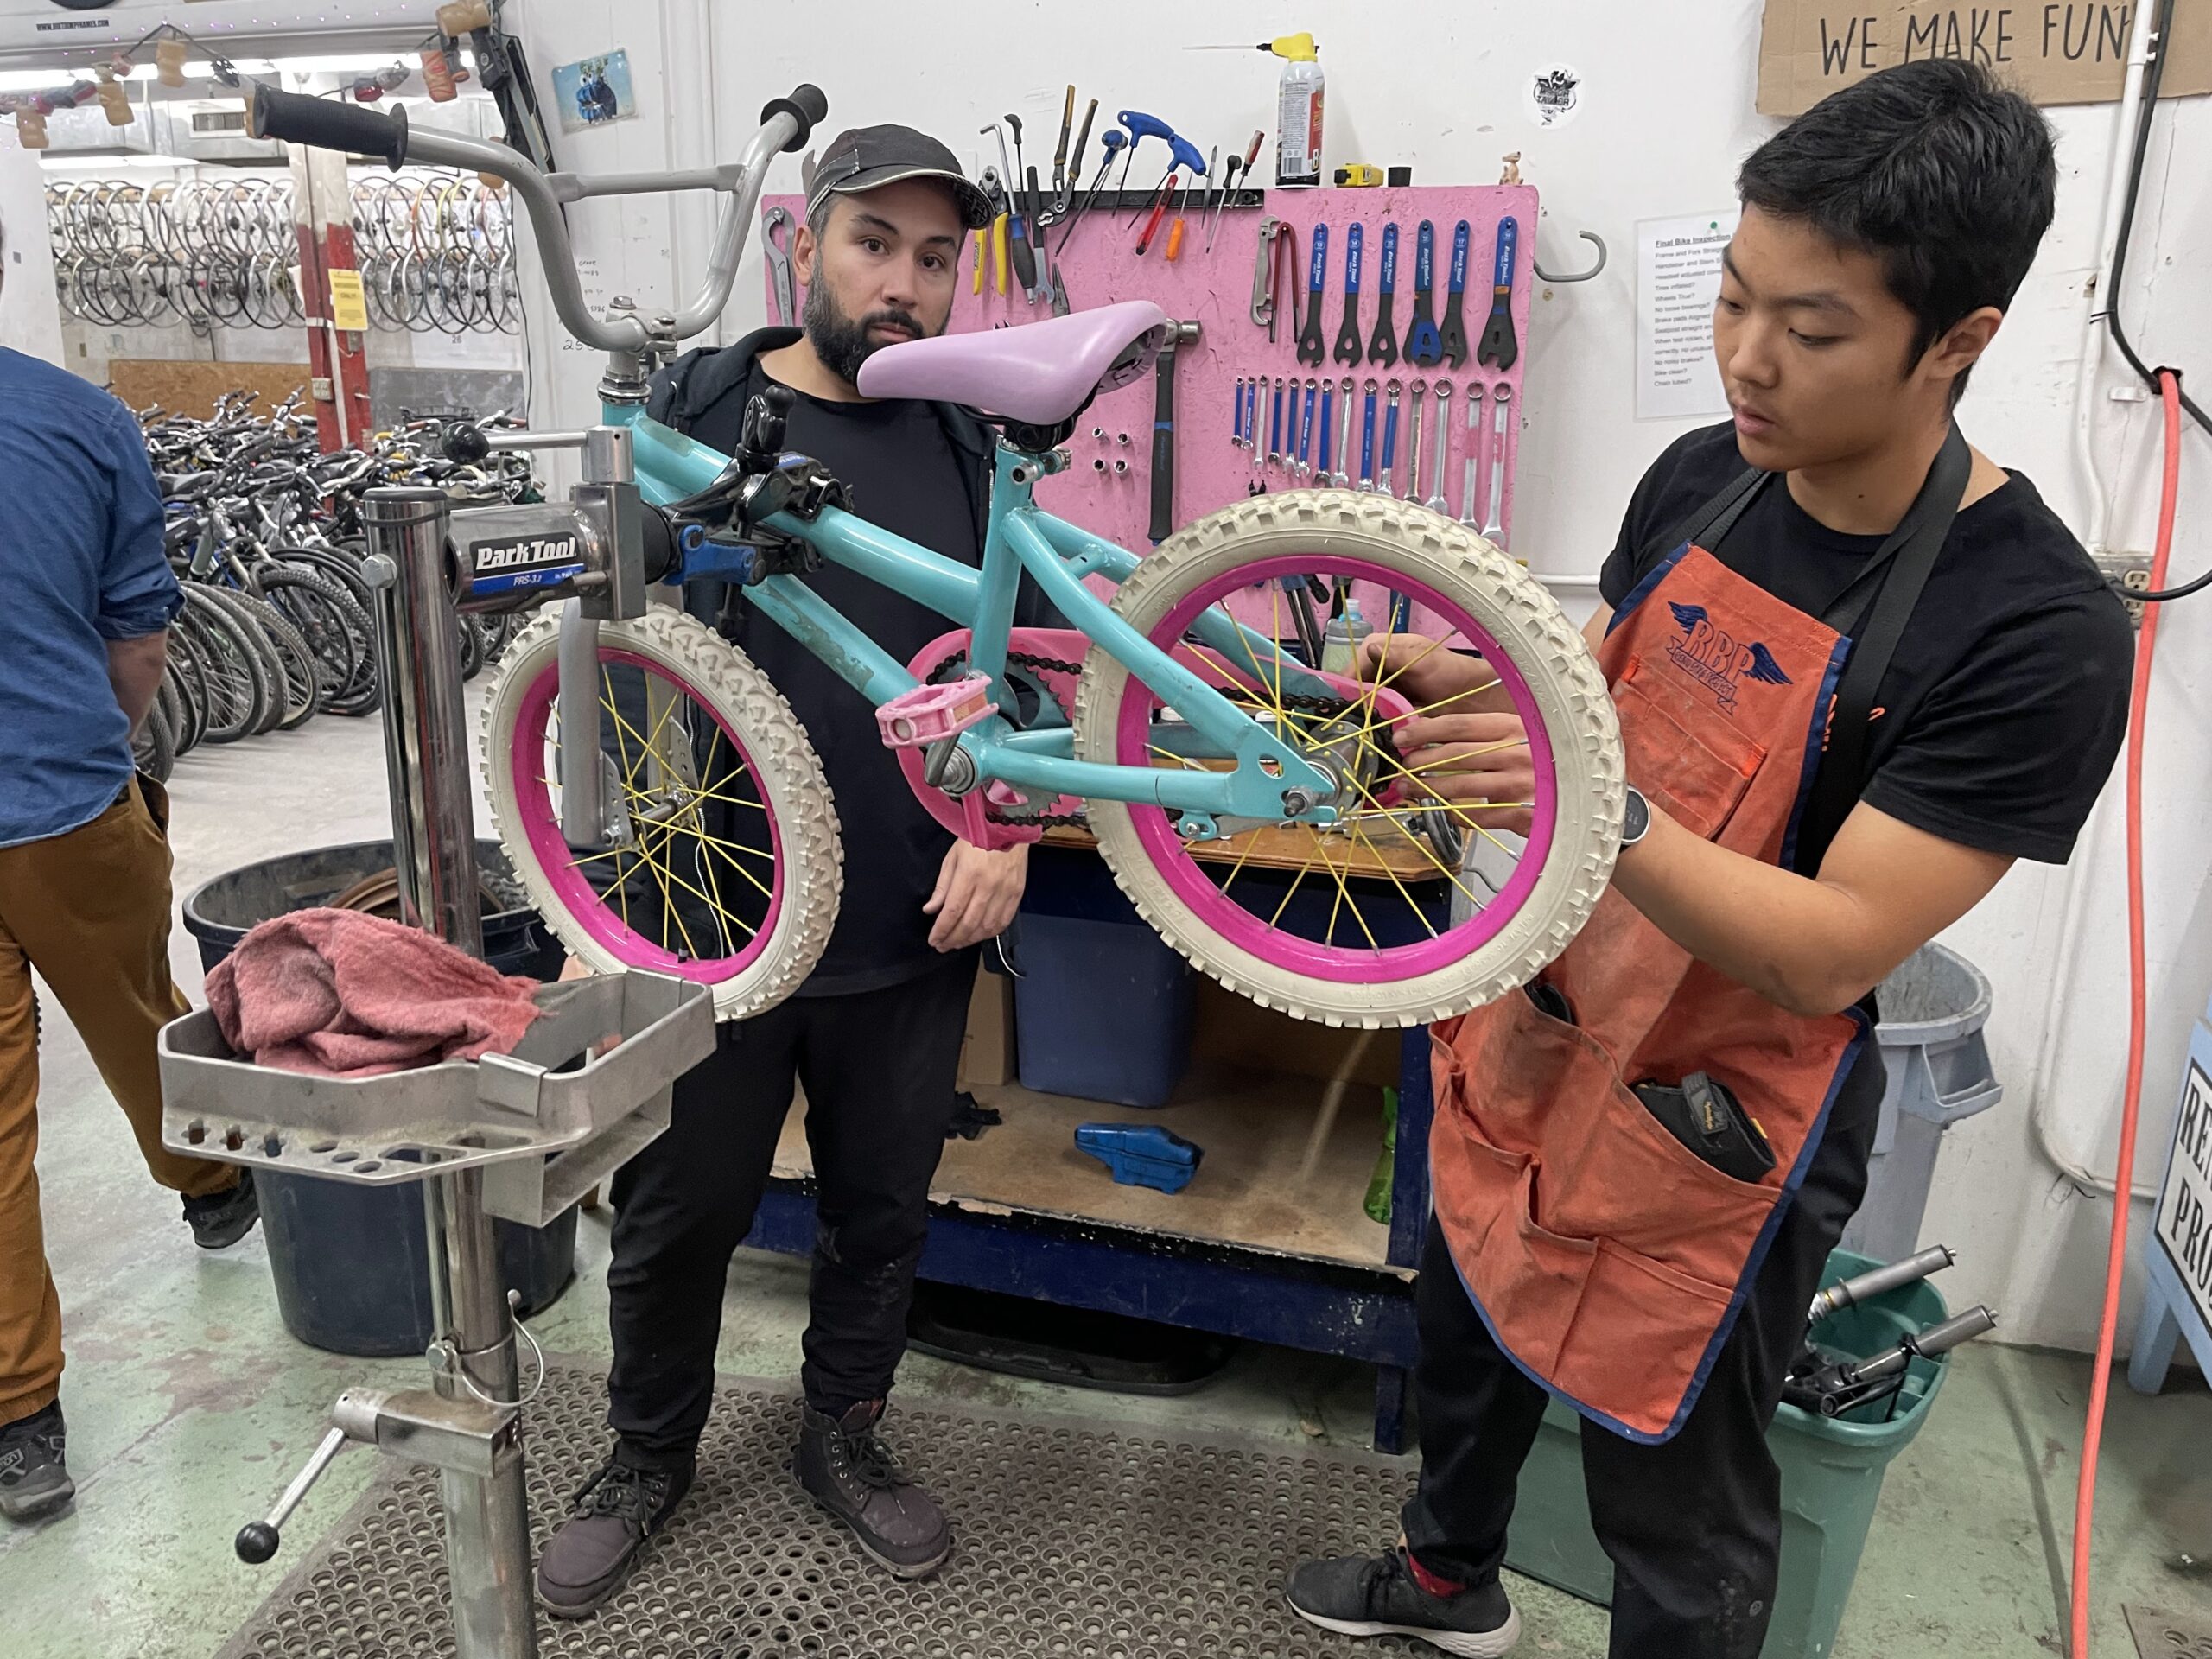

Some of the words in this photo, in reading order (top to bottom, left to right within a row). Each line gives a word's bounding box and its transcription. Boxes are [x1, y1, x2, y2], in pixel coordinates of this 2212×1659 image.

[1820, 17, 1878, 76] WE
[1905, 9, 2012, 67] MAKE
[2043, 3, 2129, 63] FUN
[1693, 235, 1731, 244] Inspection
[1681, 618, 1756, 683] RBP
[2171, 1176, 2212, 1311] PRO
